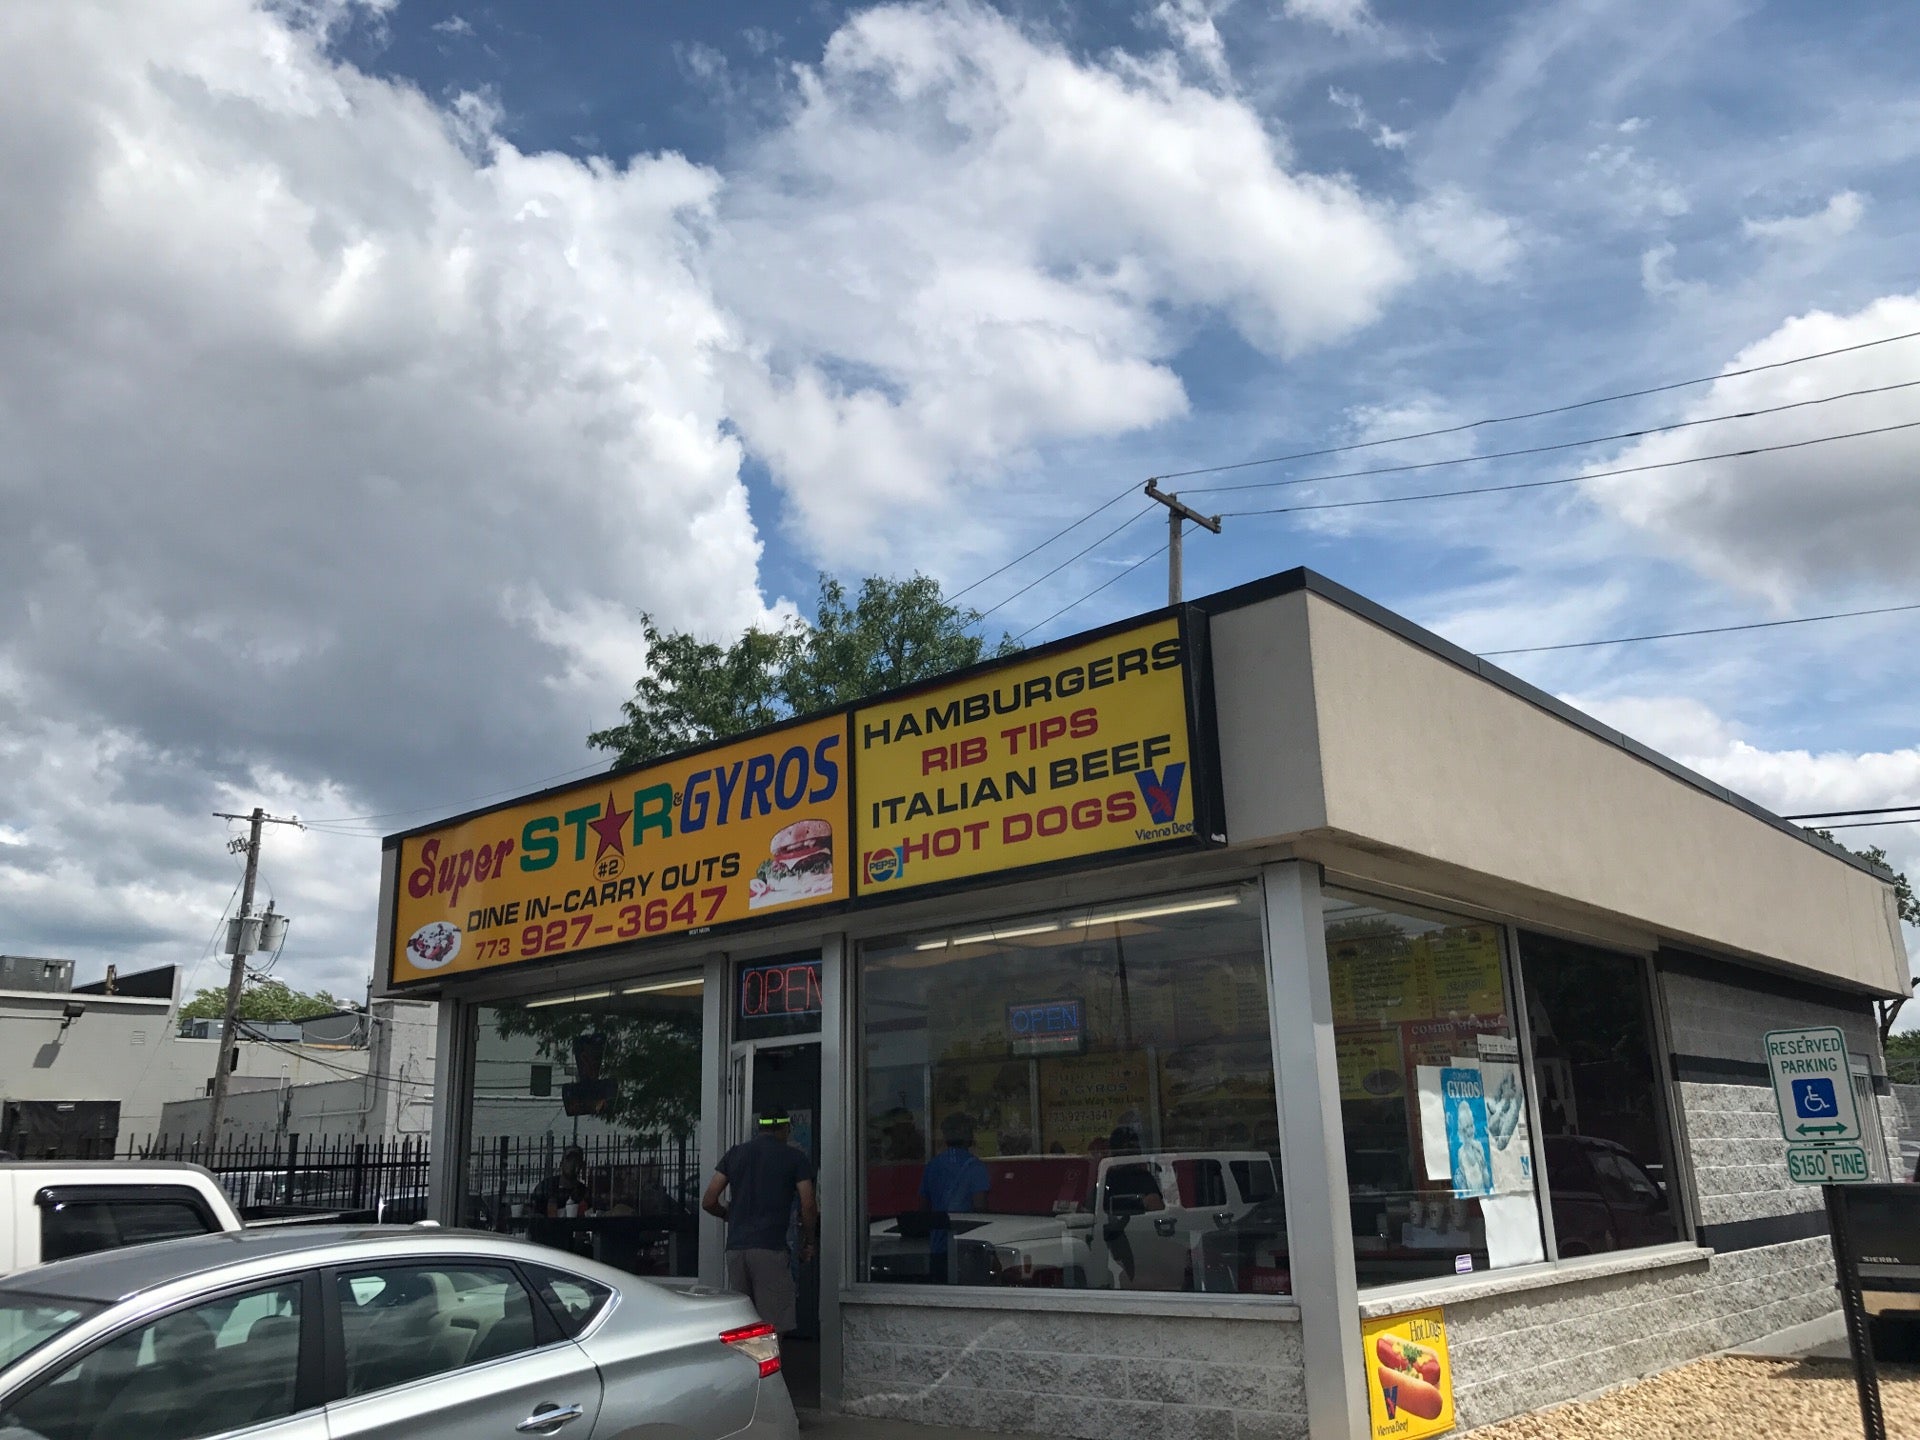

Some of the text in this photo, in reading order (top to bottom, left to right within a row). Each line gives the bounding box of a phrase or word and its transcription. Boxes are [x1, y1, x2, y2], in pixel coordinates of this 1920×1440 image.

[864, 638, 1182, 749] HAMBURGERS
[922, 707, 1098, 776] RIB TIPS
[872, 734, 1171, 829] ITALIAN BEEF
[408, 838, 514, 908] Super
[673, 791, 683, 807] &
[679, 734, 840, 834] GYROS
[902, 790, 1137, 864] HOT DOGS
[1135, 828, 1171, 841] Vienna
[598, 858, 619, 876] #2
[869, 857, 897, 871] PEPSI
[467, 852, 741, 933] DINE IN-CARRY OUTS
[475, 885, 728, 961] 773 927-3647
[1013, 1005, 1078, 1033] OPEN
[1411, 1024, 1454, 1035] COMBO
[1770, 1037, 1841, 1056] RESERVED
[1781, 1057, 1838, 1073] PARKING
[1075, 1083, 1127, 1094] GYROS
[1447, 1080, 1480, 1098] GYROS
[1832, 1153, 1865, 1175] FINE
[1862, 1256, 1900, 1264] SIERRA
[1409, 1318, 1442, 1343] Hot Dogs
[1377, 1418, 1409, 1436] Vienna Beef
